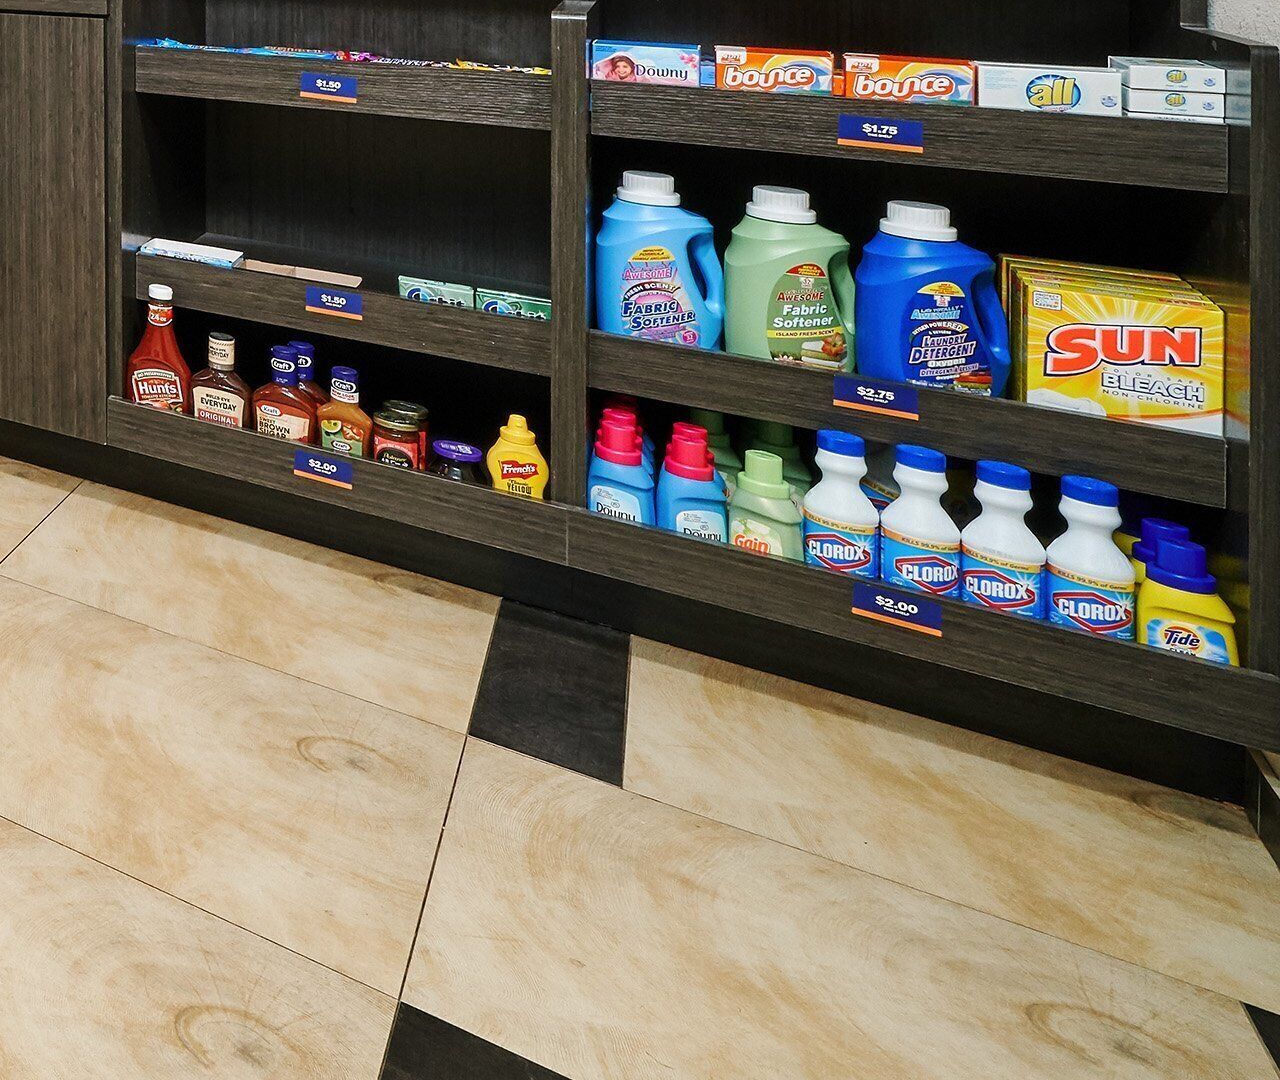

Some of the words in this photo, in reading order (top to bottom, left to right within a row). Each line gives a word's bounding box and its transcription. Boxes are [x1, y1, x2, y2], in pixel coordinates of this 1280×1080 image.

[636, 65, 689, 80] Downy
[726, 65, 812, 87] bounce
[316, 78, 341, 90] $1.50
[857, 74, 952, 97] bounce
[1029, 77, 1076, 108] all
[862, 123, 898, 136] $1.75
[321, 294, 346, 306] $1.50
[776, 291, 824, 302] AWESOME
[622, 300, 678, 316] FABRIC
[783, 303, 828, 316] Fabric
[630, 311, 695, 330] SOFTENER
[773, 317, 834, 328] Softener
[922, 333, 967, 348] LAUNDRY
[909, 341, 976, 364] DETERGENT
[1044, 323, 1202, 377] SUN
[273, 360, 290, 370] Kraft
[335, 380, 353, 390] Kraft
[1101, 373, 1205, 403] BLEACH
[856, 386, 895, 401] $2.75
[1103, 390, 1204, 410] NON-CHLORINE
[200, 397, 237, 412] EVERYDAY
[263, 405, 278, 415] Kraft
[200, 411, 237, 425] ORIGINAL
[259, 421, 291, 435] BROWN
[308, 459, 337, 472] $2.00
[502, 463, 536, 475] French's
[507, 483, 532, 494] YELLOW
[734, 533, 770, 555] Gain
[808, 540, 867, 562] CLOROX
[902, 564, 957, 583] CLOROX
[965, 579, 1030, 601] CLOROX
[875, 595, 919, 617] $2.00
[1058, 599, 1128, 621] CLOROX
[1164, 629, 1201, 648] Tide
